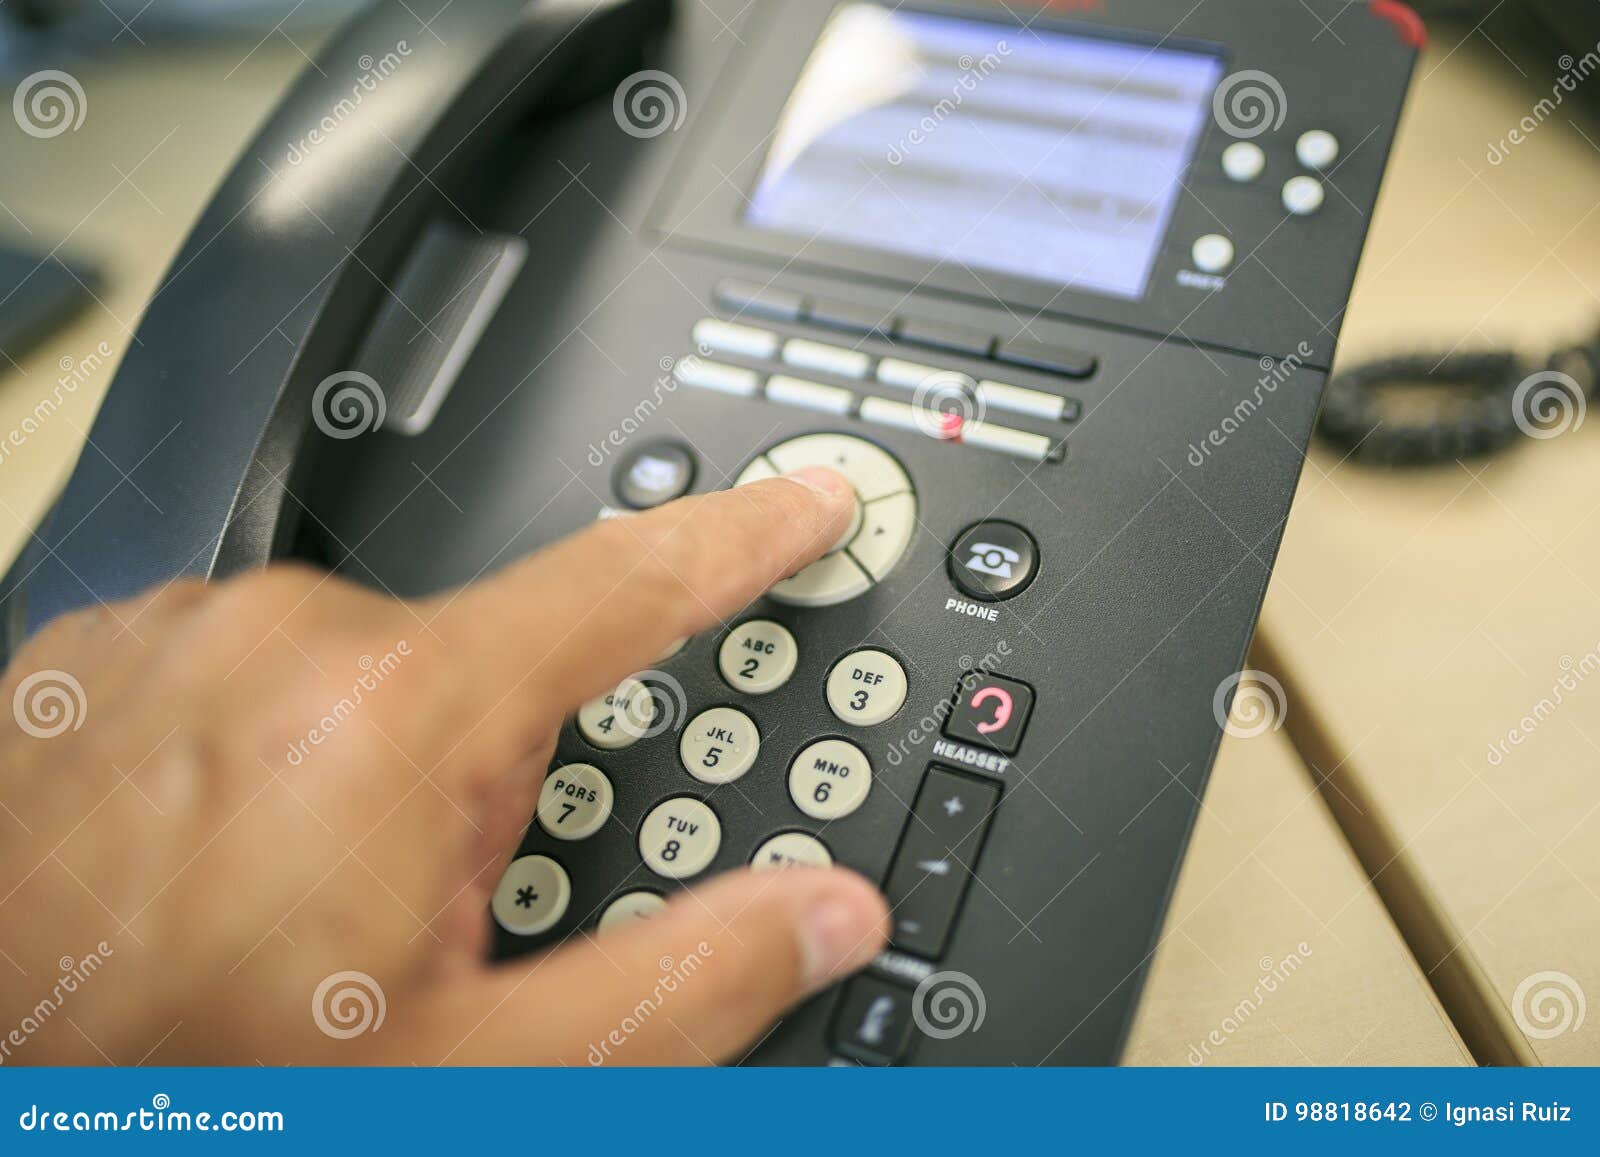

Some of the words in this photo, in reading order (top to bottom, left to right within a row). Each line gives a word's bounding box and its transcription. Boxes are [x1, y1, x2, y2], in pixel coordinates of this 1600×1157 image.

[945, 599, 998, 622] PHONE
[742, 637, 775, 655] ABC
[739, 658, 760, 679] 2
[852, 668, 884, 686] DEF
[849, 690, 869, 711] 3
[597, 715, 616, 734] 4
[706, 726, 735, 745] JKL
[702, 747, 723, 768] 5
[932, 740, 1009, 774] HEADSET
[813, 758, 850, 778] MNO
[553, 779, 597, 803] PQRS
[813, 782, 832, 803] 6
[557, 803, 576, 824] 7
[666, 816, 699, 836] TUV
[661, 840, 681, 862] 8
